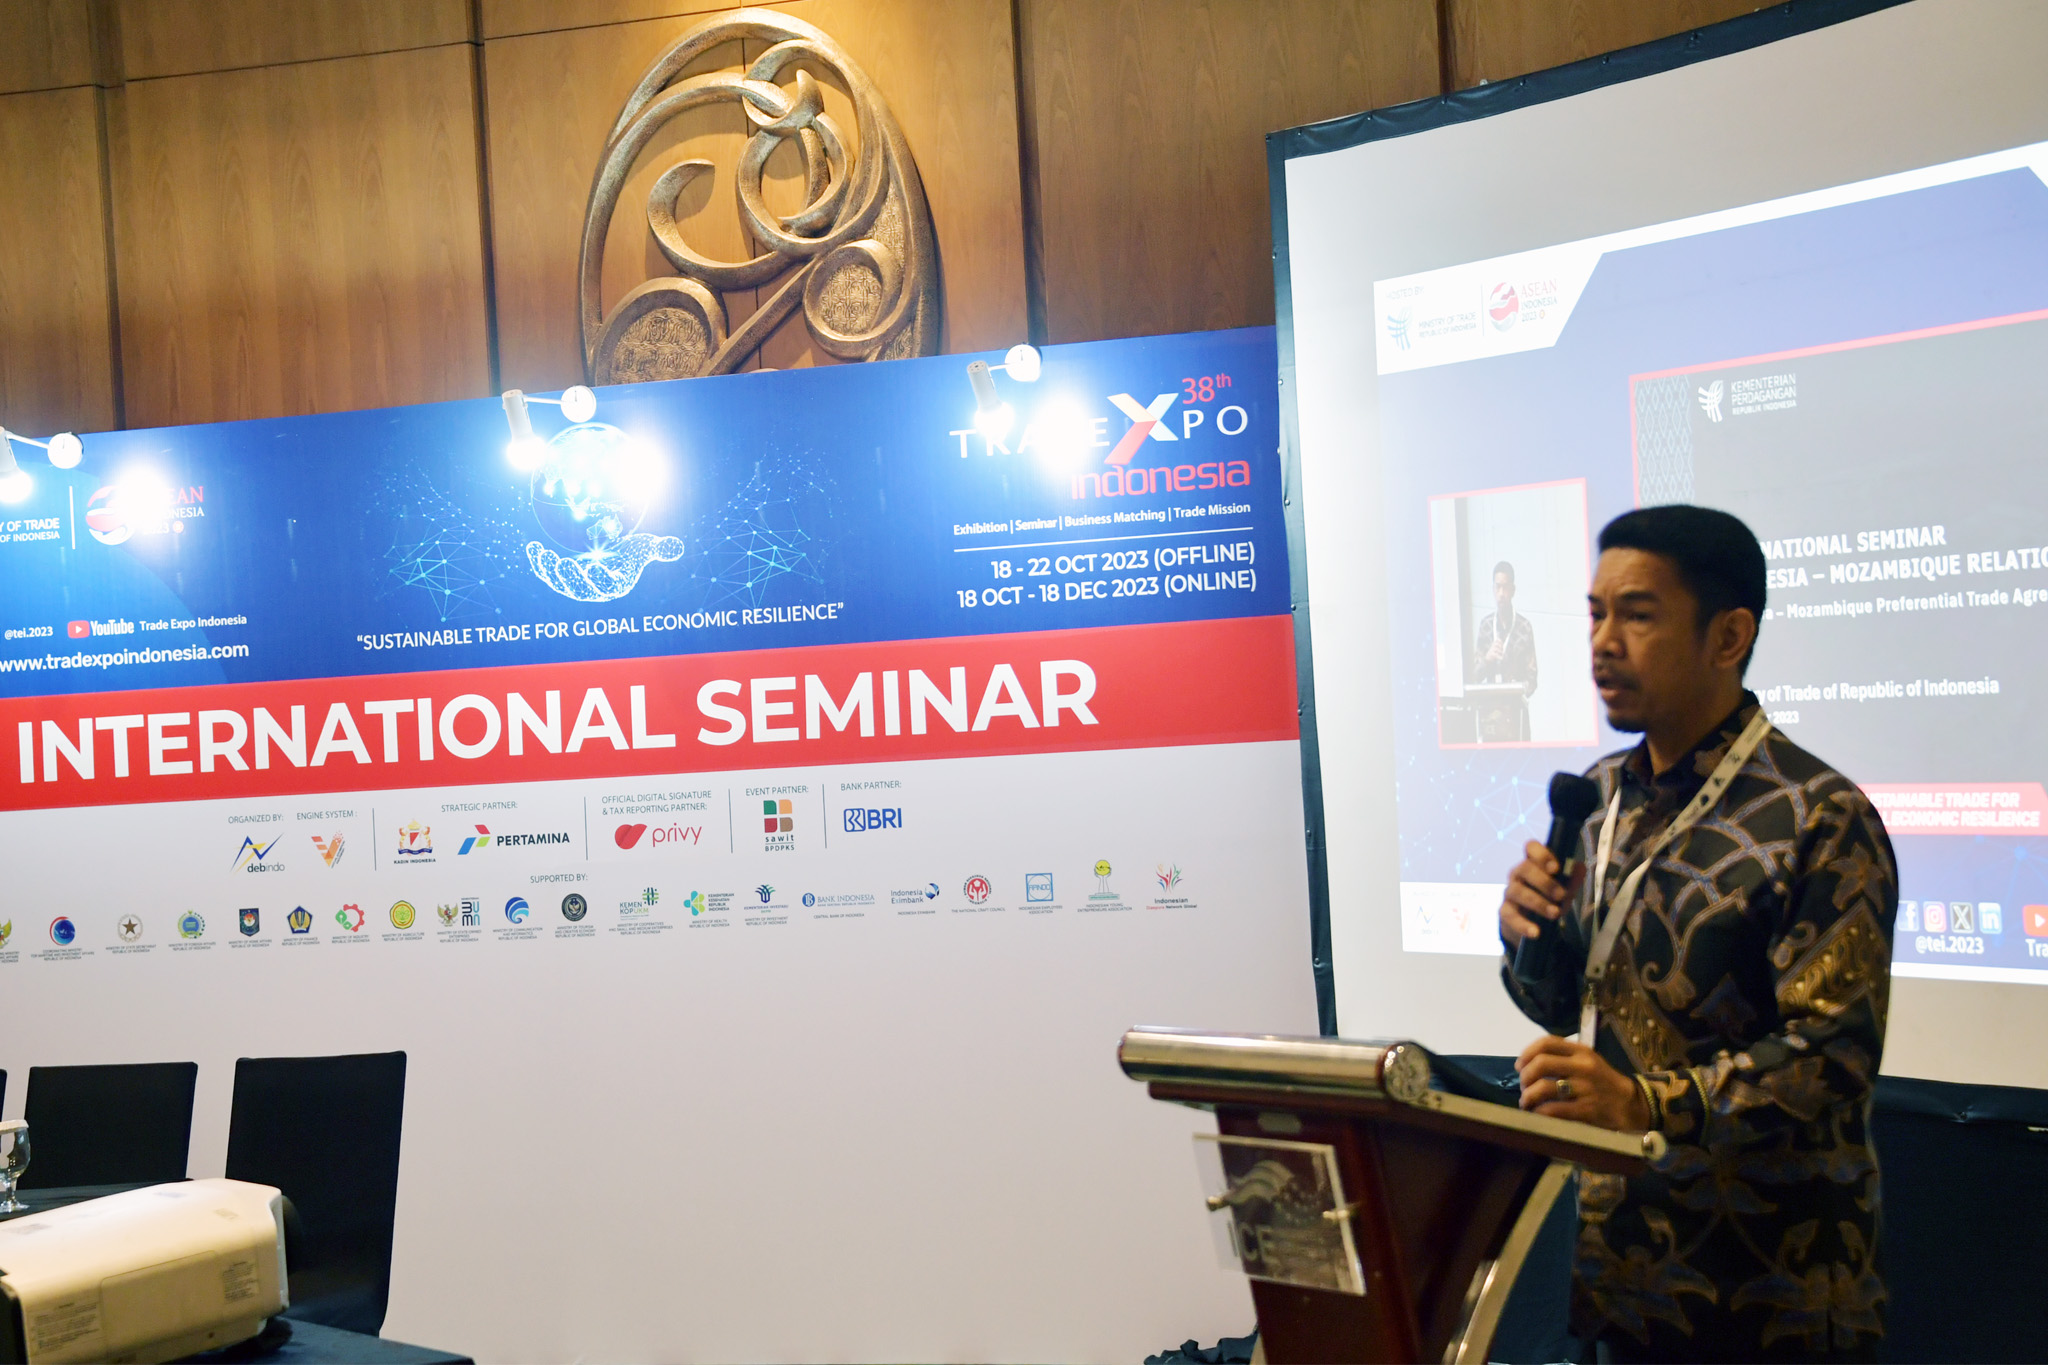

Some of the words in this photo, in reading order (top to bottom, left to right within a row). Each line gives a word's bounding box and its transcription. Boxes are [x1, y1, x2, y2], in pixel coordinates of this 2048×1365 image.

[1521, 279, 1558, 298] ASEAN
[1521, 296, 1558, 311] INDONESIA
[1418, 317, 1446, 329] MINISTRY
[1521, 311, 1537, 323] 2023
[1731, 374, 1796, 393] KEMENTERIAN
[1731, 386, 1797, 405] PERDAGANGAN
[1732, 405, 1762, 415] REPUBLIK
[1763, 400, 1796, 411] INDONESIA
[7, 520, 22, 532] OF
[24, 517, 61, 531] TRADE
[953, 521, 1008, 536] Exhibition
[1015, 517, 1058, 532] Seminar
[1064, 512, 1112, 528] Business
[1113, 507, 1166, 524] Matching
[1173, 505, 1206, 520] Trade
[1208, 502, 1251, 516] Mission
[0, 534, 11, 543] OF
[13, 530, 61, 542] INDONESIA
[1760, 534, 1852, 560] NATIONAL
[1857, 525, 1947, 552] SEMINAR
[991, 560, 1012, 579] 18
[1027, 557, 1051, 577] 22
[1055, 553, 1097, 575] OCT
[1101, 550, 1149, 572] 2023
[1154, 541, 1256, 571] (OFFLINE)
[1830, 554, 1961, 584] MOZAMBIQUE
[1967, 546, 2048, 574] RELATIO
[956, 589, 977, 608] 18
[981, 585, 1024, 606] OCT
[1039, 583, 1060, 602] 18
[1065, 580, 1107, 601] DEC
[1111, 576, 1159, 598] 2023
[1164, 568, 1257, 598] (ONLINE)
[1787, 598, 1873, 619] Mozambique
[1876, 592, 1964, 613] Preferential
[1966, 588, 2009, 606] Trade
[2012, 587, 2048, 608] Agre
[4, 625, 54, 641] @tei.2023
[90, 618, 135, 637] YouTube
[139, 620, 169, 632] Trade
[171, 616, 196, 631] Expo
[197, 614, 248, 629] Indonesia
[475, 623, 531, 644] TRADE
[535, 620, 570, 639] FOR
[573, 616, 640, 637] GLOBAL
[643, 609, 738, 634] ECONOMIC
[0, 643, 250, 673] www.tradexpoindonesia.com
[1766, 688, 1781, 702] of
[1783, 685, 1821, 702] Trade
[1823, 683, 1838, 700] of
[1840, 680, 1904, 703] Republic
[1906, 679, 1922, 698] of
[1924, 676, 2000, 696] Indonesia
[17, 685, 676, 784] INTERNATIONAL
[696, 659, 1101, 747] SEMINAR
[1773, 710, 1800, 725] 2023
[745, 787, 770, 797] EVENT
[772, 785, 809, 796] PARTNER:
[840, 782, 863, 791] BANK
[864, 780, 902, 791] PARTNER:
[602, 795, 636, 804] OFFICIAL
[637, 792, 667, 803] DIGITAL
[669, 790, 712, 801] SIGNATURE
[1945, 792, 1990, 808] TRADE
[1991, 792, 2020, 808] FOR
[441, 802, 481, 813] STRATEGIC
[482, 801, 518, 812] PARTNER:
[610, 807, 625, 815] TAX
[626, 804, 670, 814] REPORTING
[671, 802, 707, 813] PARTNER:
[228, 814, 271, 825] ORGANIZED
[272, 813, 284, 823] BY:
[296, 811, 324, 821] ENGINE
[325, 810, 354, 819] SYSTEM
[867, 808, 903, 830] BRI
[1891, 810, 1960, 828] ECONOMIC
[1961, 810, 2040, 828] RESILIENCE
[497, 832, 570, 847] PERTAMINA
[652, 822, 702, 848] privy
[765, 834, 794, 843] sawit
[247, 861, 285, 873] debindo
[530, 873, 575, 884] SUPPORTED
[576, 872, 588, 883] BY:
[817, 896, 835, 904] BANK
[837, 893, 875, 903] INDONESIA
[891, 889, 923, 897] Indonesia
[891, 896, 924, 904] Eximbank
[1915, 935, 1985, 955] @tei.2023
[2025, 938, 2048, 958] Tra
